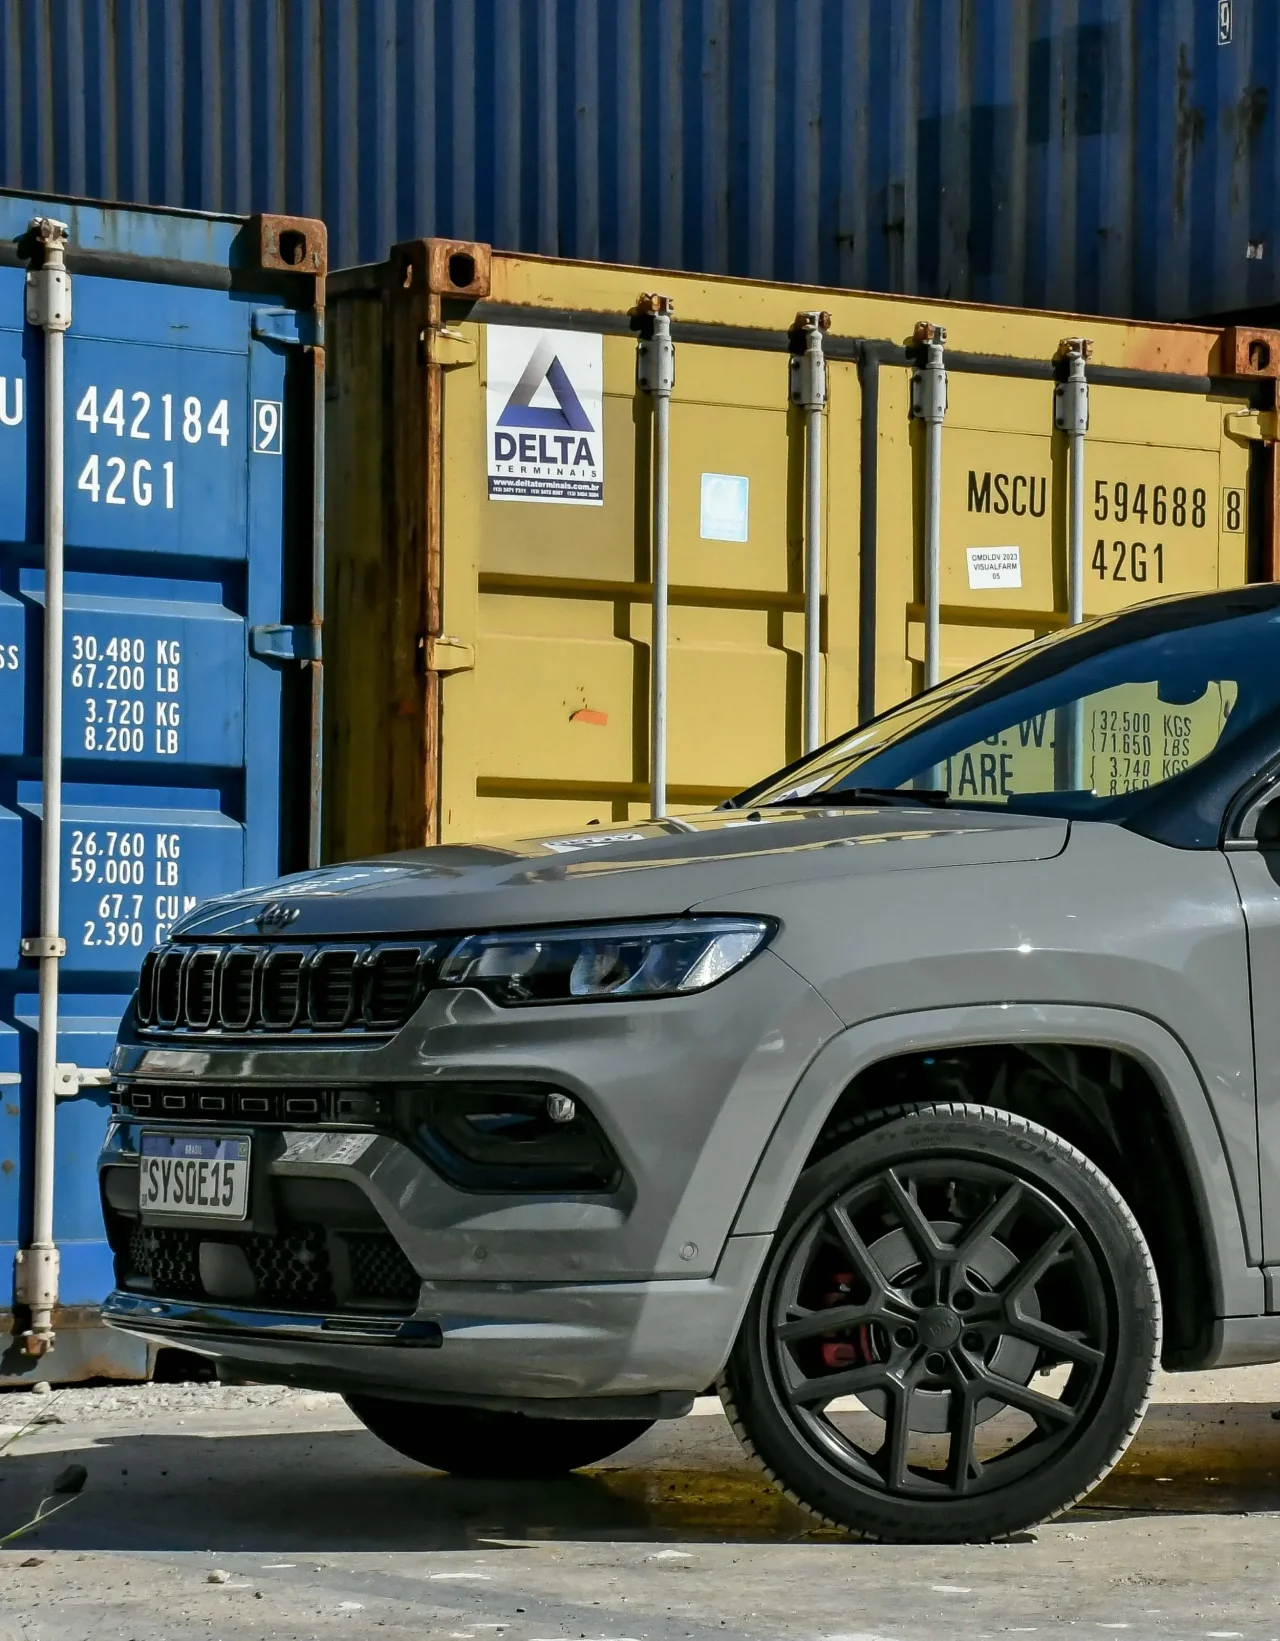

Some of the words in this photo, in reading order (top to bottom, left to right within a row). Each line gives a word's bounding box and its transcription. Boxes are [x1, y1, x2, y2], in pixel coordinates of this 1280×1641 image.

[1220, 2, 1230, 40] 9
[0, 376, 23, 426] U
[76, 385, 230, 447] 442184
[258, 403, 279, 450] 9
[494, 431, 596, 467] DELTA
[77, 454, 175, 509] 42G1
[493, 478, 600, 491] www.deltaterminais.com.br
[495, 464, 598, 478] TERMINAIS
[967, 470, 1047, 518] MSCU
[1093, 479, 1207, 529] 594688
[1225, 490, 1242, 531] 8
[1091, 539, 1165, 584] 42G1
[71, 635, 146, 665] 30,480
[156, 639, 181, 666] KG
[71, 663, 145, 691] 67,200
[156, 667, 180, 693] LB
[84, 697, 145, 726] 3,720
[156, 701, 180, 727] KG
[1163, 714, 1192, 738] KGS
[84, 726, 145, 752] 8,200
[156, 729, 179, 755] LB
[1163, 738, 1190, 757] LBS
[71, 830, 145, 857] 26,760
[156, 834, 180, 859] KG
[70, 858, 145, 885] 59,000
[156, 861, 179, 886] LB
[99, 894, 143, 919] 67.7
[155, 896, 179, 920] CU
[83, 921, 143, 946] 2,390
[185, 1144, 202, 1155] BRASIL
